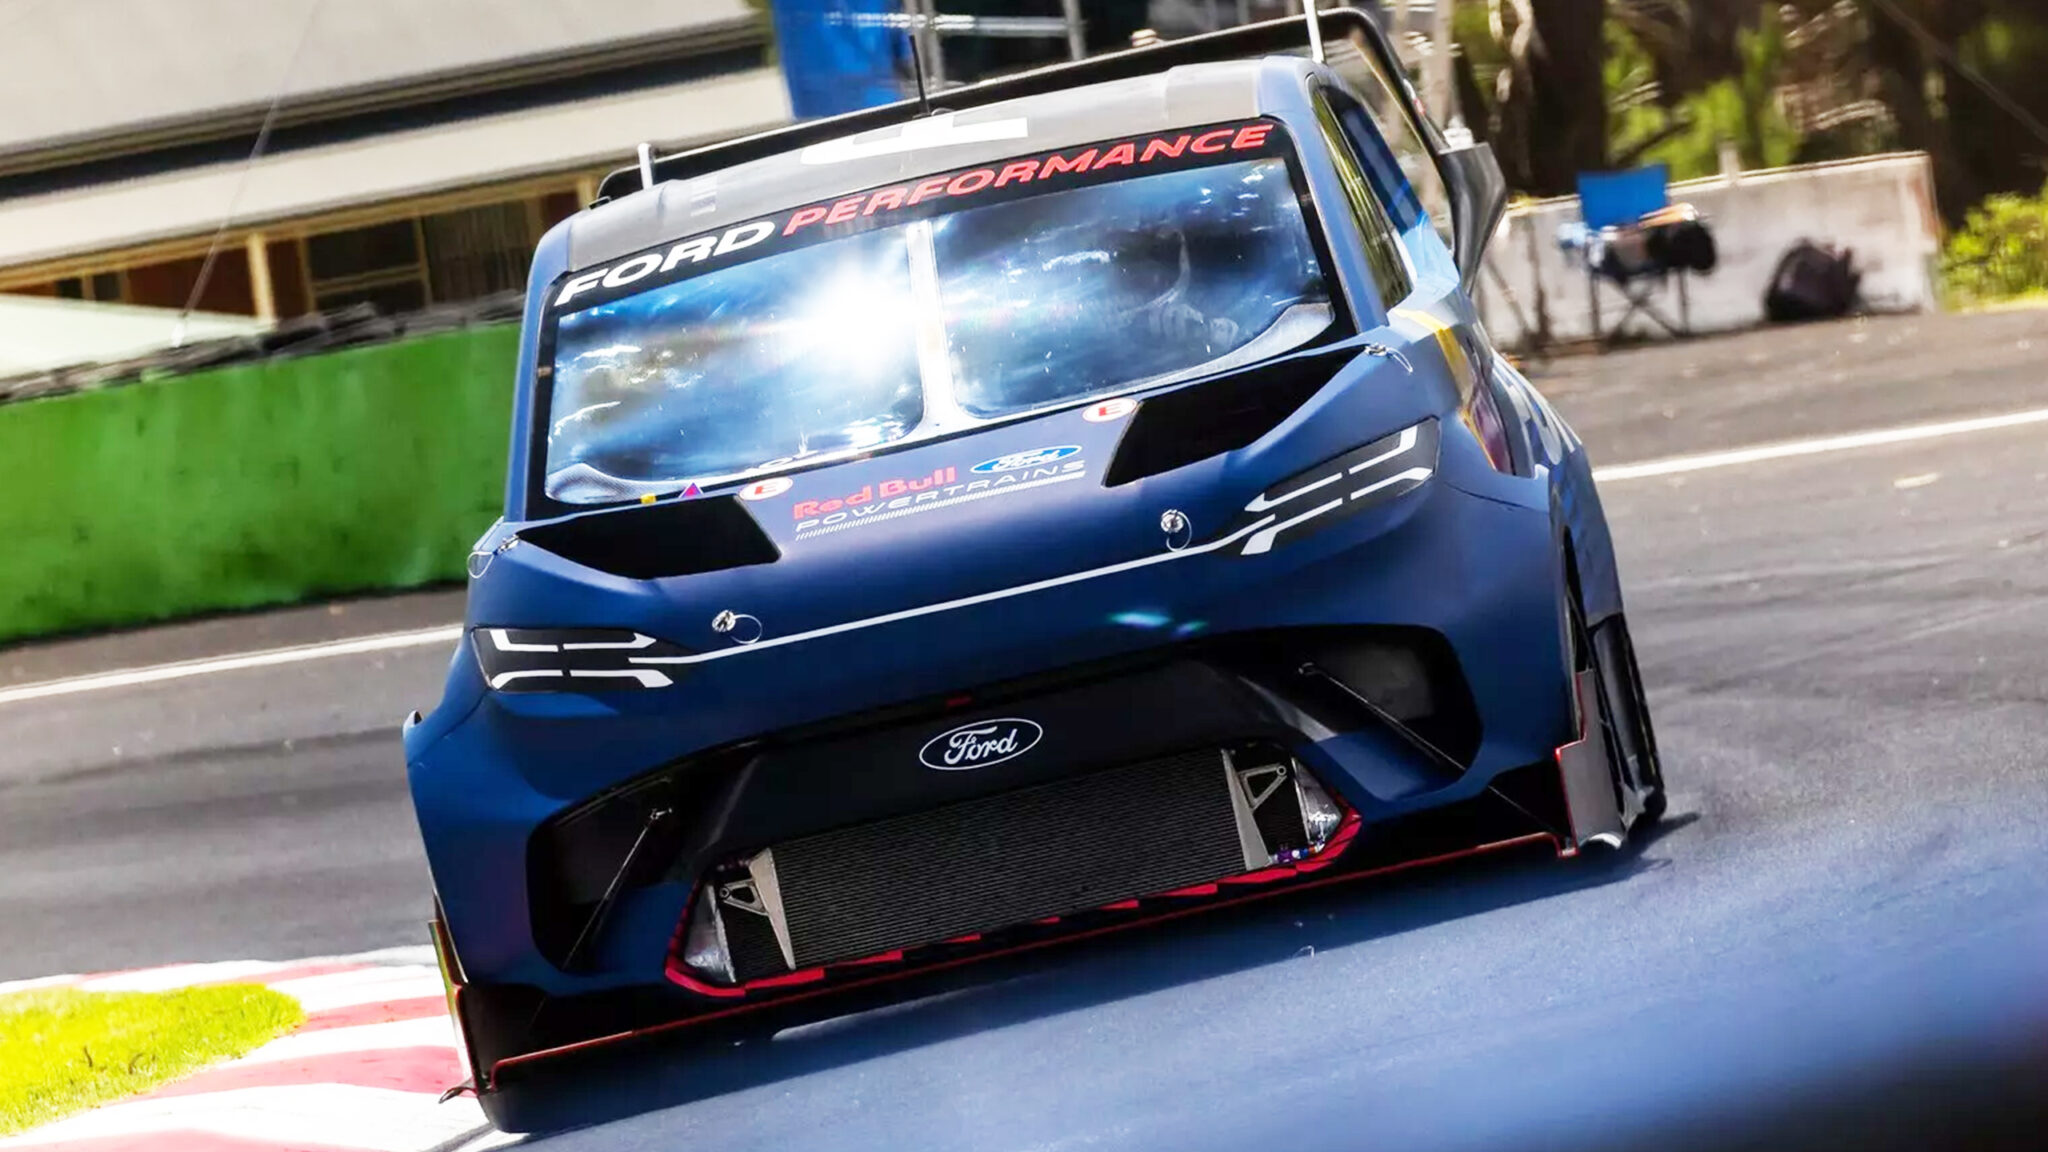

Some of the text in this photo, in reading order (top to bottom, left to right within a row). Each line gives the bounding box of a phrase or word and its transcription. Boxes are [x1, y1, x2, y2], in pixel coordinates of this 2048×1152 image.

[554, 221, 776, 307] FORD
[782, 124, 1275, 237] PERFORMANCE
[1098, 402, 1121, 417] E
[992, 449, 1061, 472] Ford
[754, 481, 778, 496] E
[793, 466, 957, 520] Red Bull
[795, 460, 1085, 532] POWERTRAINS
[944, 726, 1018, 765] Ford
